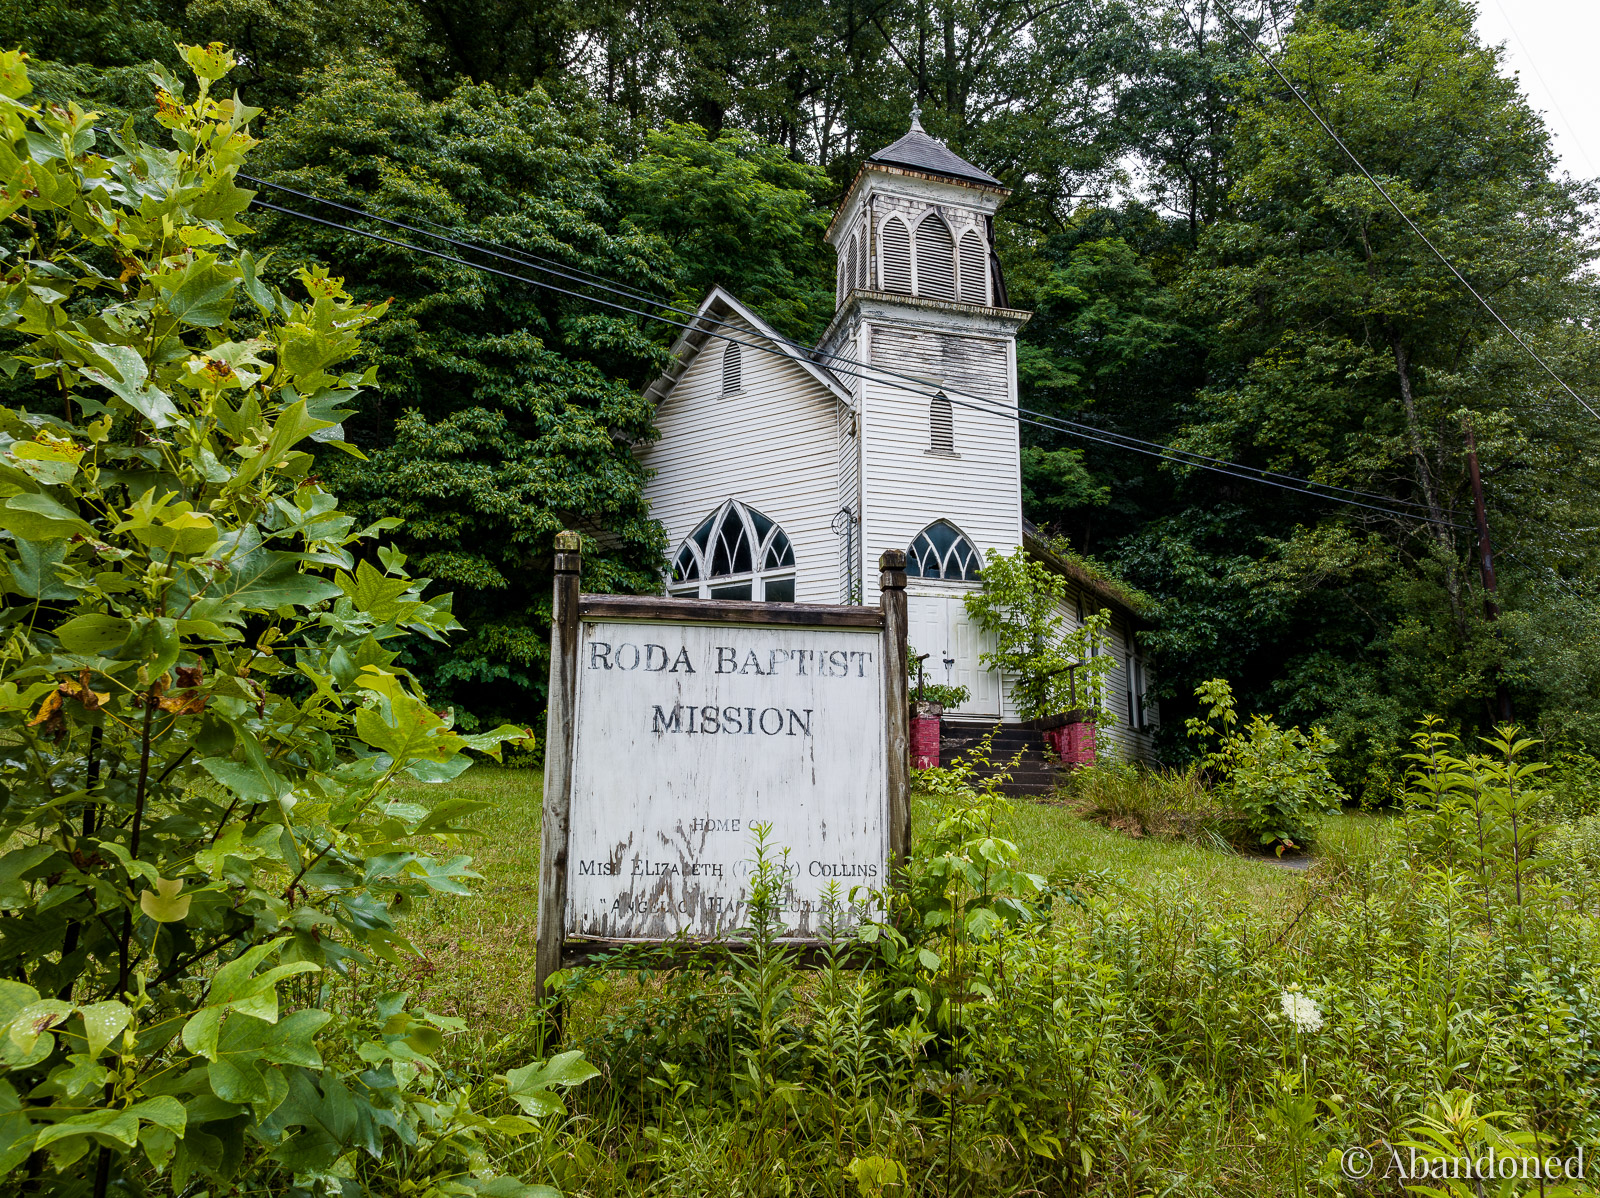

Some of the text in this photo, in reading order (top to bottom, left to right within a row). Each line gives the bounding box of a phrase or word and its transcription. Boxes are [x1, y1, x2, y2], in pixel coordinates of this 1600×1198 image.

[588, 642, 873, 678] RODA BAPTIST
[651, 705, 814, 737] MISSION
[692, 818, 741, 832] HOME
[578, 859, 619, 876] MIS
[631, 859, 724, 877] ELIZAETH
[808, 860, 878, 877] COLLINS
